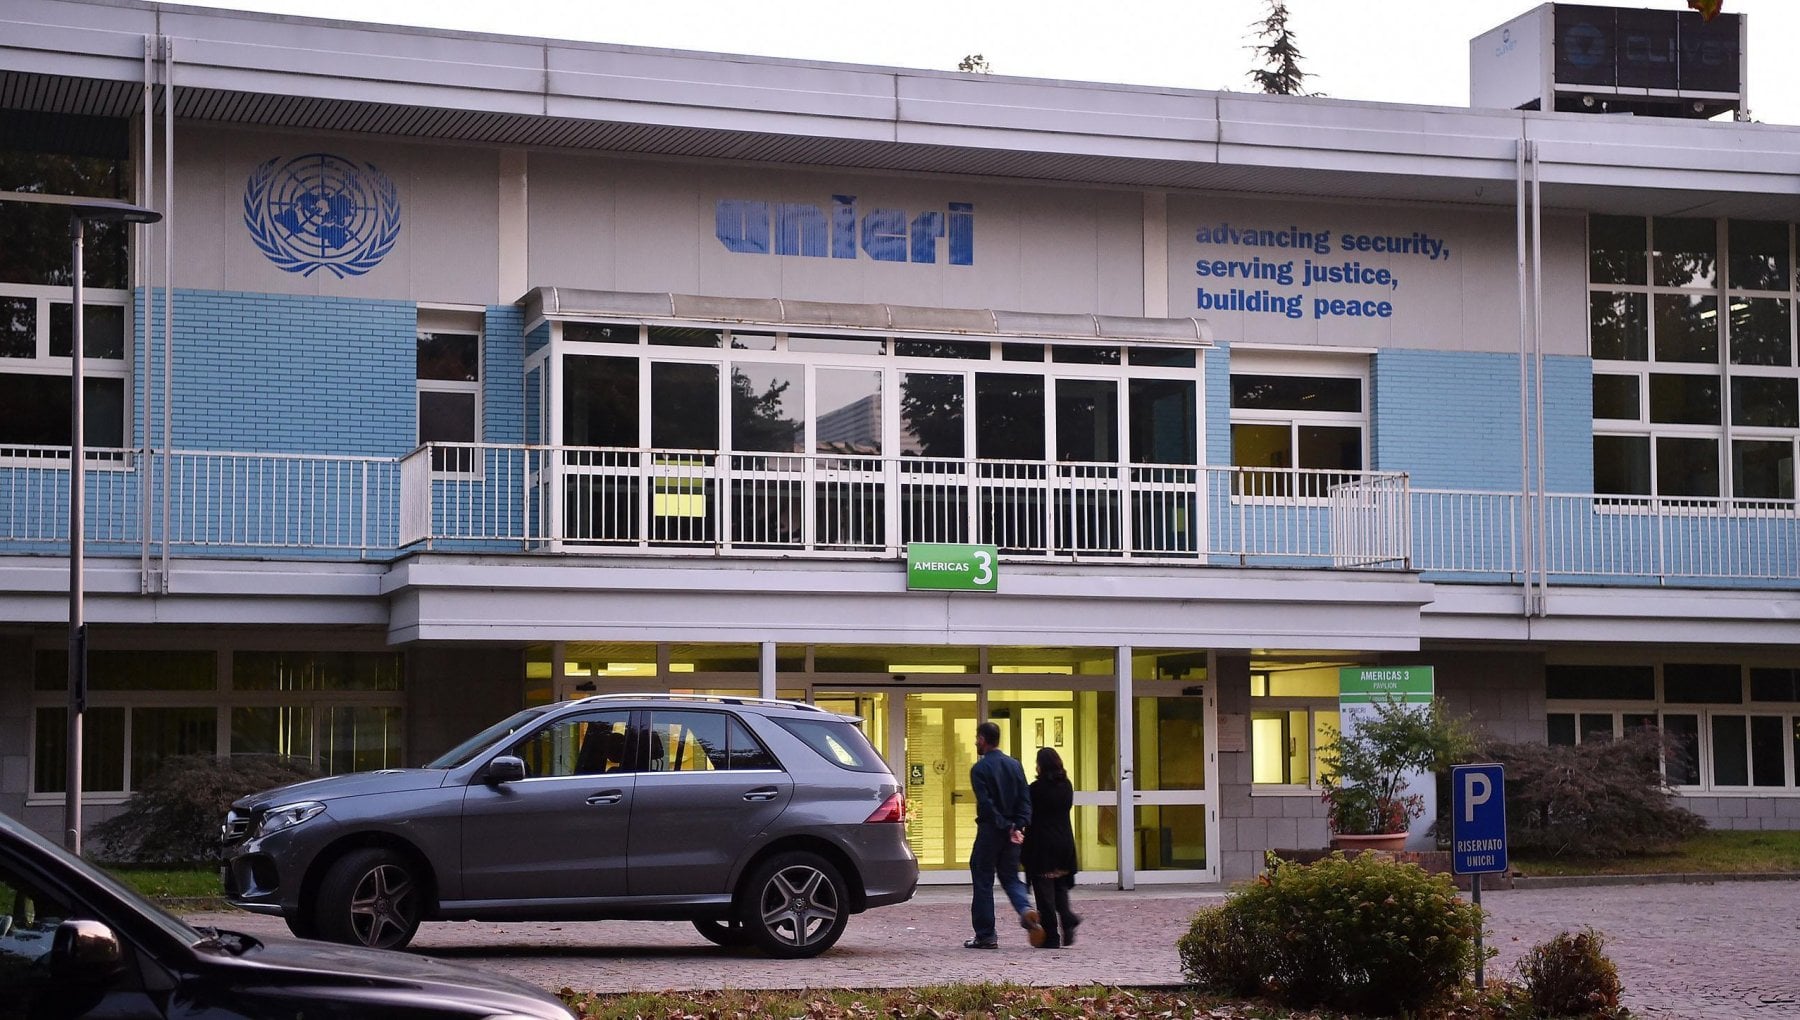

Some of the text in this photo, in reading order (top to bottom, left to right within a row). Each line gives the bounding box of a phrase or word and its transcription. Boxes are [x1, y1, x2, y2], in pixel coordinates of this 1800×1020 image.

[715, 194, 973, 266] unicri
[1196, 222, 1450, 261] advancing security,
[1196, 256, 1398, 290] serving justice,
[1197, 288, 1393, 320] building peace
[914, 550, 993, 585] AMERICAS 3
[1360, 671, 1410, 681] AMERICAS 3
[1464, 772, 1492, 822] P
[1457, 838, 1503, 853] RISERVATO
[1466, 854, 1495, 867] UNICRI
